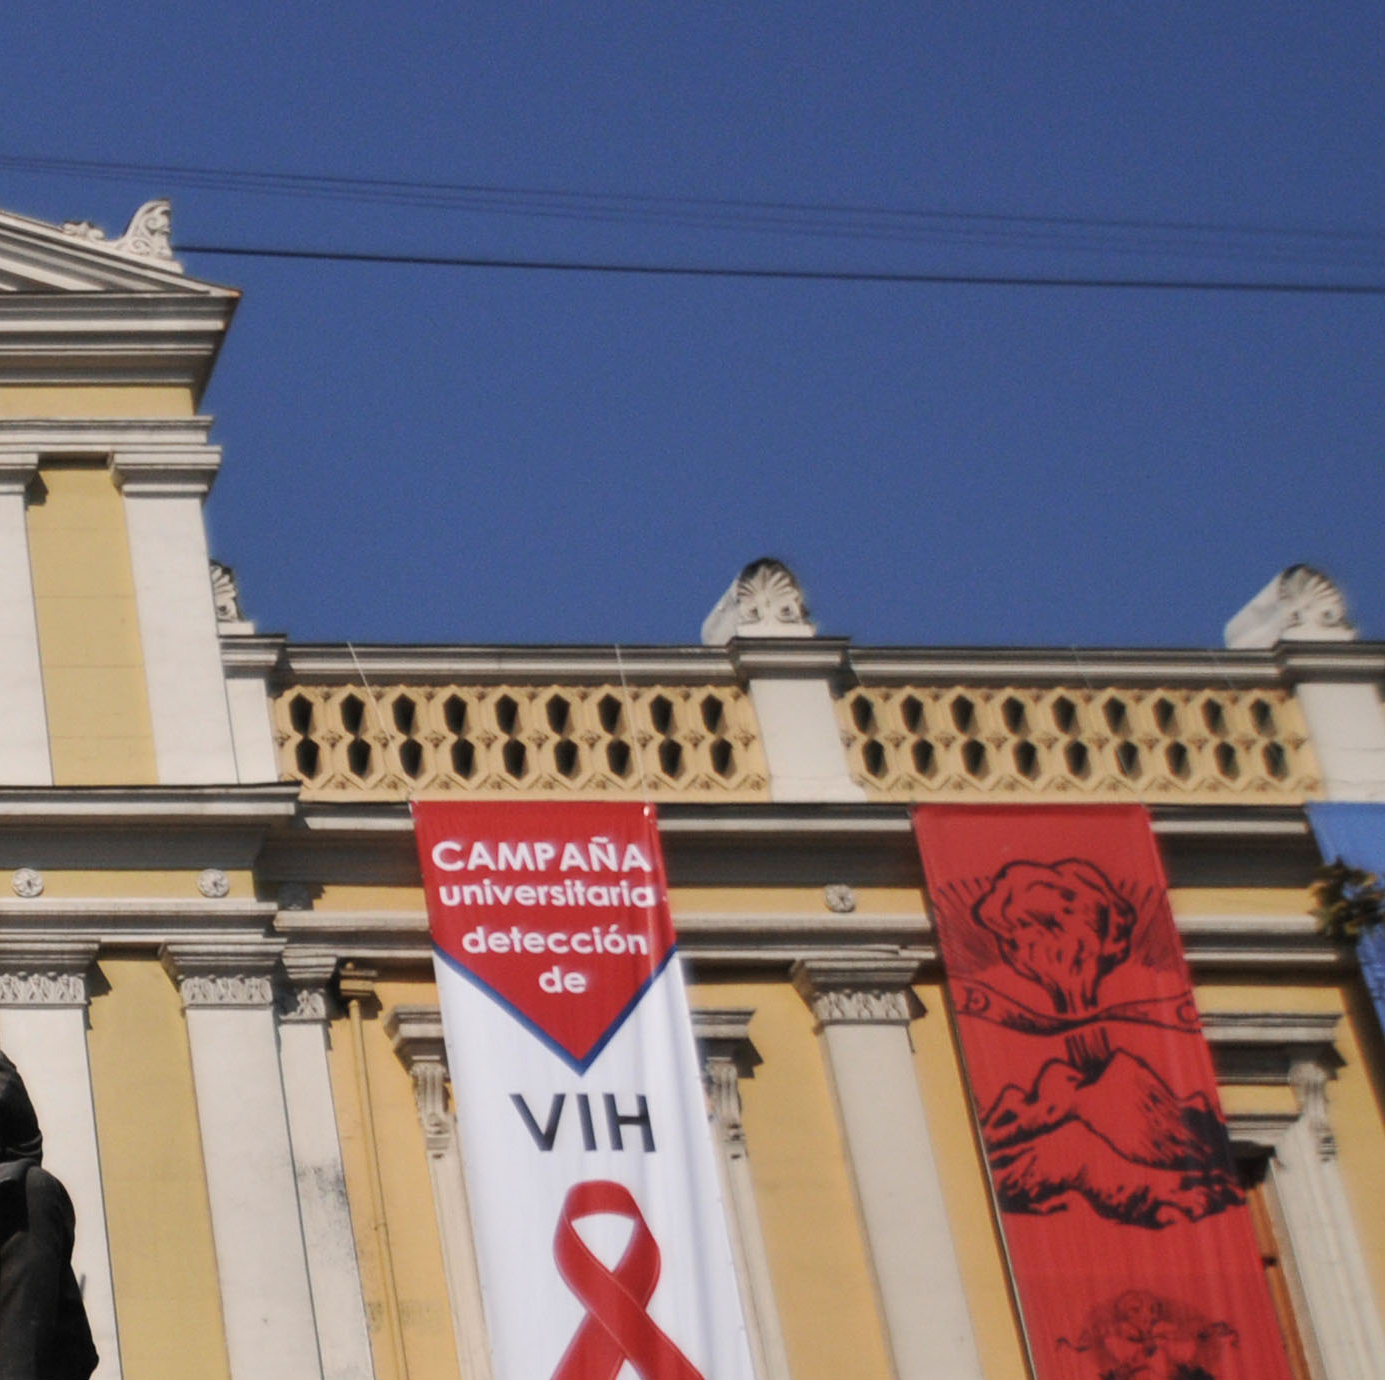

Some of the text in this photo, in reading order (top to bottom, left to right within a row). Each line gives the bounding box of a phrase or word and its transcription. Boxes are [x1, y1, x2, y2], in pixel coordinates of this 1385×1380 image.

[431, 836, 653, 874] CAMPAÑA
[438, 878, 657, 908] universitaria
[461, 924, 649, 956] detección
[538, 965, 587, 994] de
[507, 1092, 657, 1153] VIH
